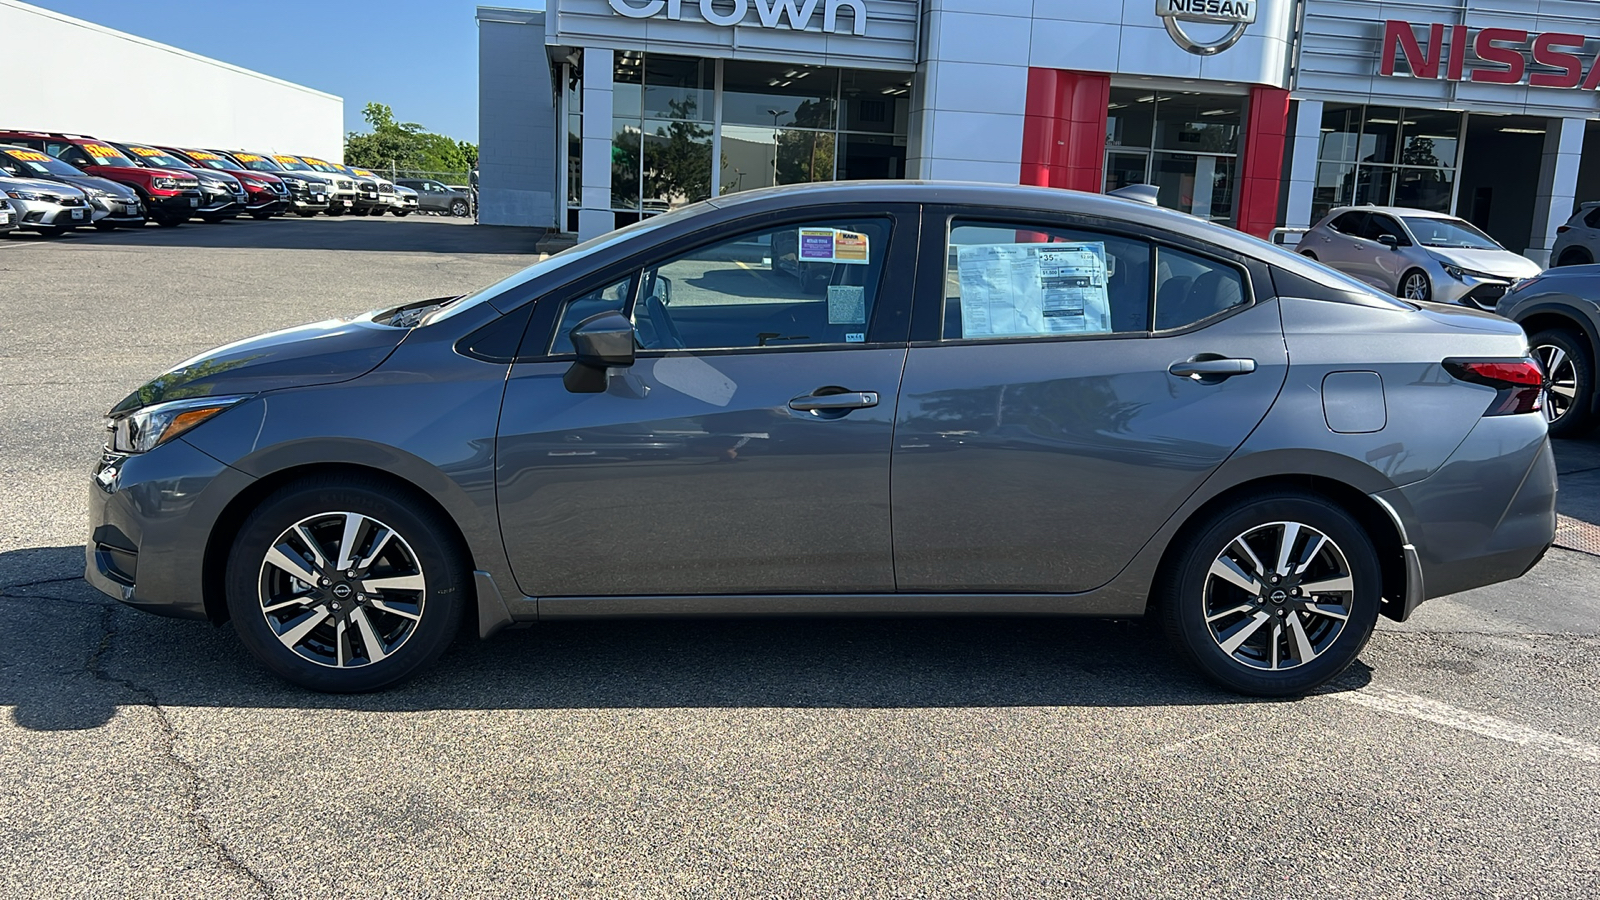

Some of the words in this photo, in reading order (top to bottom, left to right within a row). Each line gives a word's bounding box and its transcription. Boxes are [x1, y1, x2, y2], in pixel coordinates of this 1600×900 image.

[608, 0, 867, 36] own
[1168, 0, 1249, 16] NISSAN
[1380, 19, 1600, 91] NISS
[1043, 254, 1054, 262] 35
